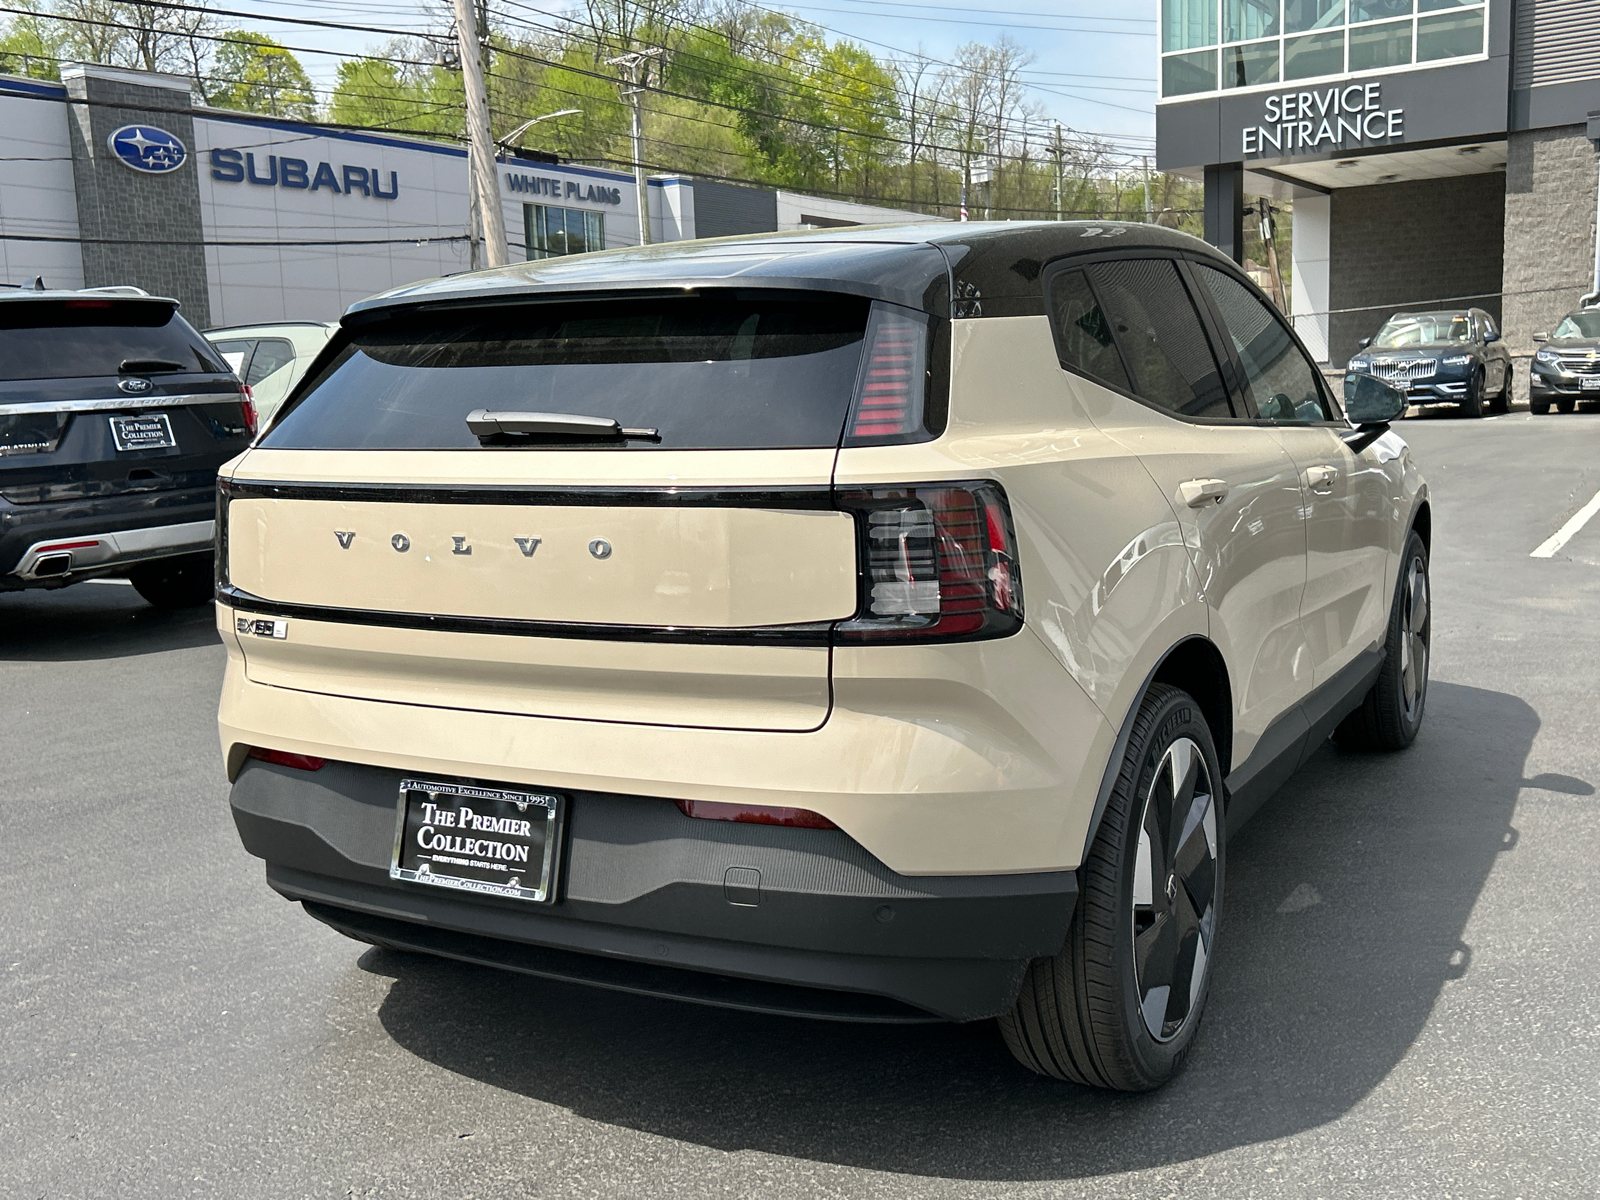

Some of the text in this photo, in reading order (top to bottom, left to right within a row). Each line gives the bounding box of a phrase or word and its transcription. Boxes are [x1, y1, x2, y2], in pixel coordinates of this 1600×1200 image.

[1264, 82, 1381, 123] SERVICE
[1242, 108, 1404, 154] ENTRANCE
[211, 148, 399, 200] SUBARU
[505, 172, 621, 205] WHITE PLAINS
[127, 380, 147, 390] Ford
[119, 422, 162, 432] THE PREMIER
[121, 430, 164, 440] COLLECTION
[333, 530, 613, 560] VOLVO
[412, 781, 545, 805] AUTOMOTIVE EXCELLENCE SINCE 1995
[421, 802, 531, 837] THE PREMIER
[417, 826, 530, 862] COLLECTION
[432, 854, 469, 866] EVERYTHING
[470, 860, 491, 869] STARTS
